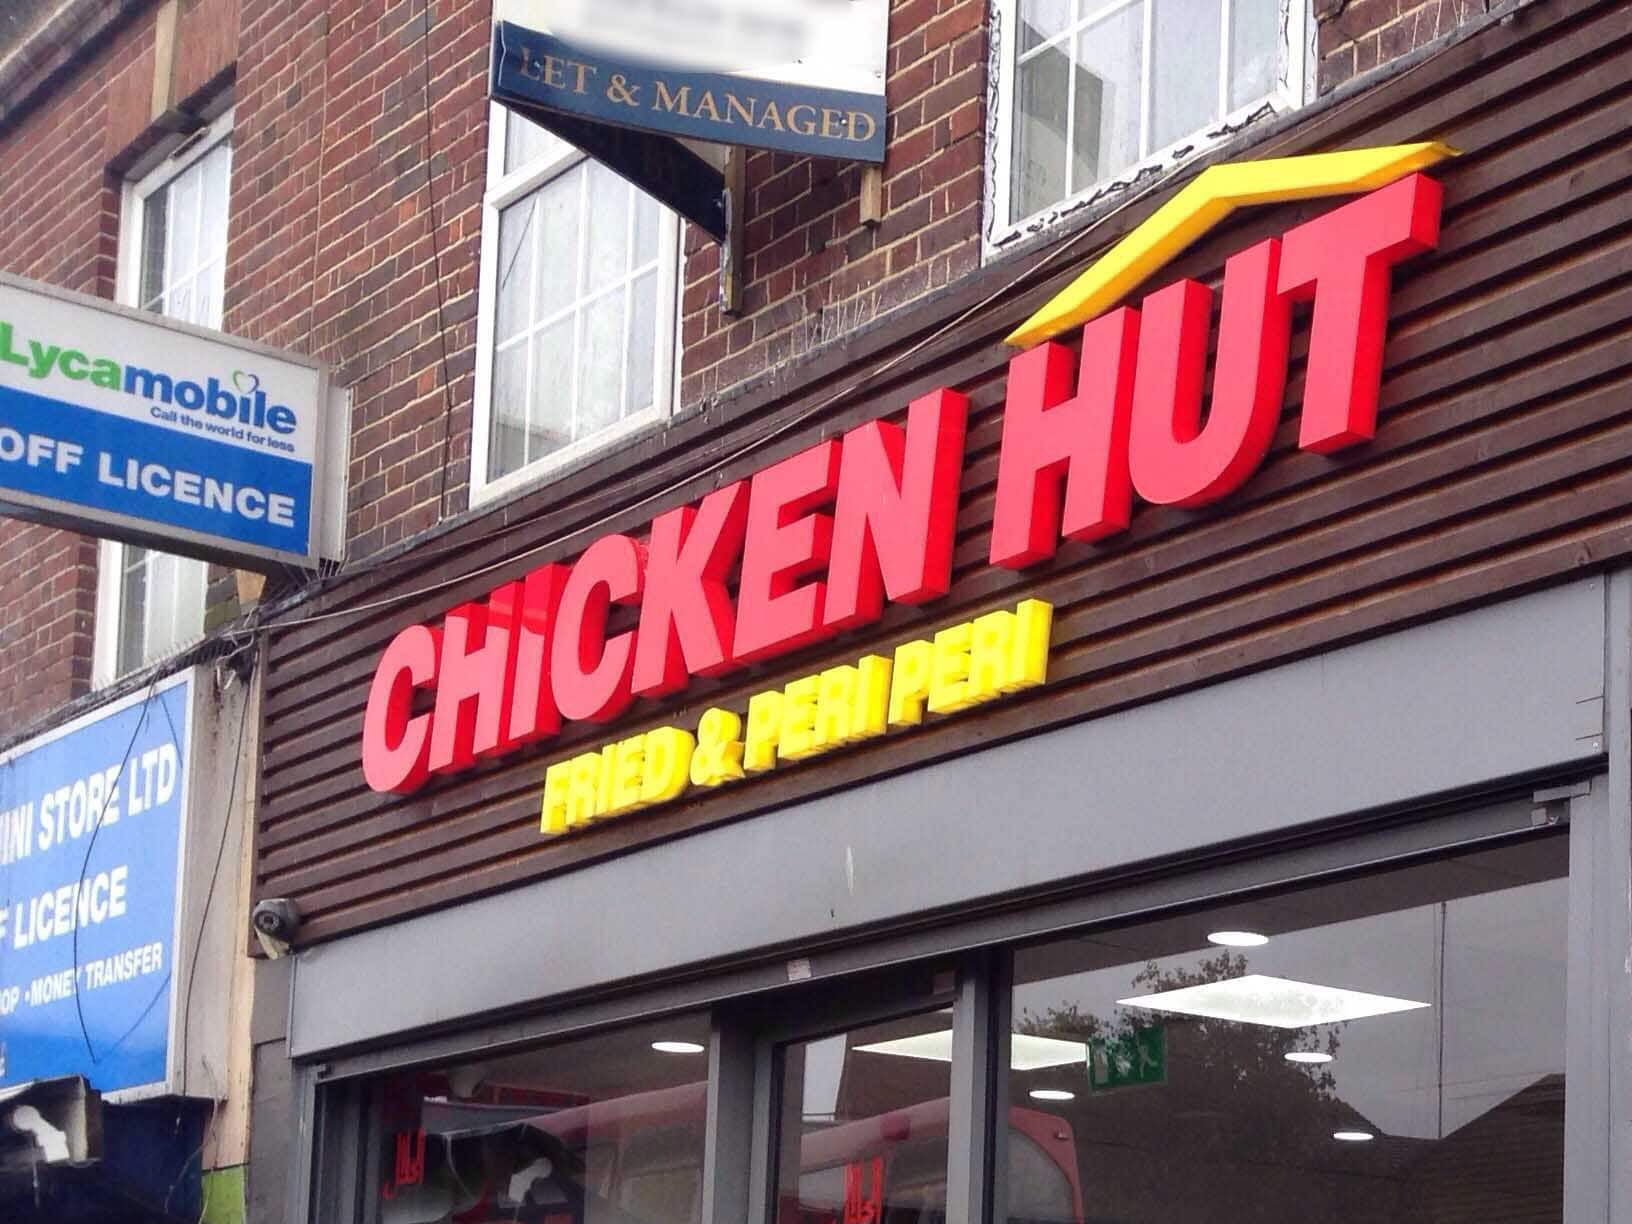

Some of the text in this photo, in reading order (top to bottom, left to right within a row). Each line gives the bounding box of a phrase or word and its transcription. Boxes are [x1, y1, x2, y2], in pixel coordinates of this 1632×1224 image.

[519, 46, 876, 143] LET & MANAGED
[0, 320, 297, 435] Lycamobile
[0, 426, 296, 528] OFF LICENCE
[150, 405, 296, 453] Call the world for less
[362, 172, 1443, 795] CHICKEN HUT
[540, 596, 1054, 835] FRIED & PERI PERI
[0, 742, 177, 865] INI STORE LTD
[13, 864, 129, 950] LICENCE
[85, 941, 164, 991] TRANSFER
